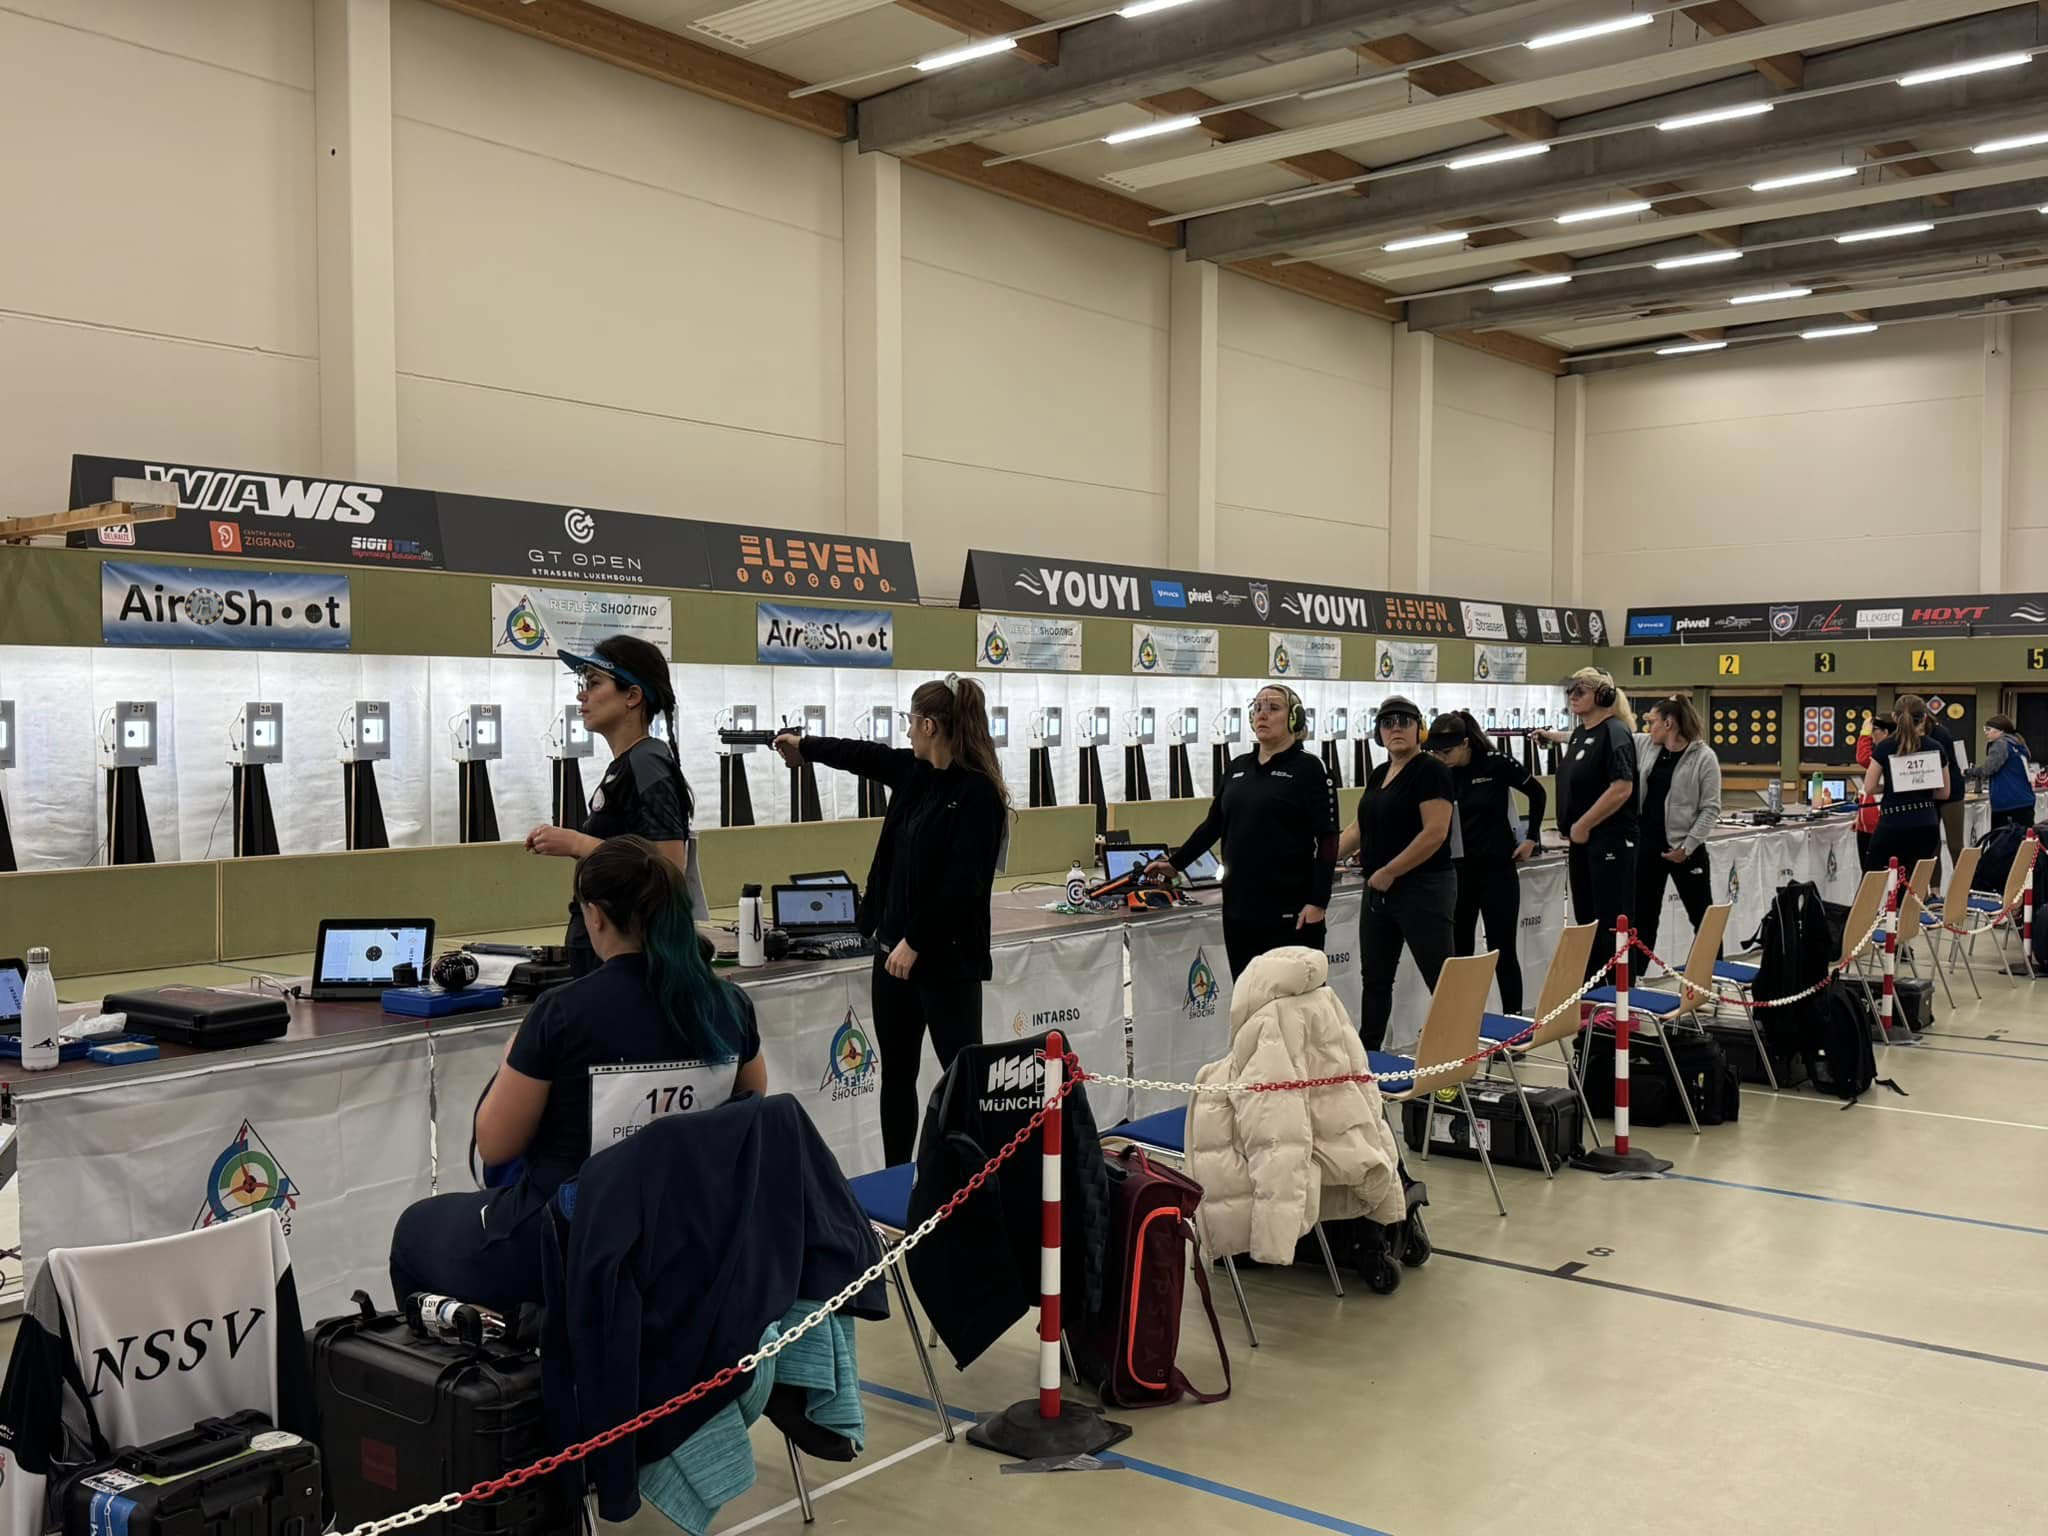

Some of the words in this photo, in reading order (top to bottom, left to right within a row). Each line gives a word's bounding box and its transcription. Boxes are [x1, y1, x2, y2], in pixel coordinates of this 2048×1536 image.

[244, 536, 297, 549] ZIGRAND
[528, 549, 562, 564] GT
[572, 553, 642, 570] OPEN
[739, 534, 880, 576] ELEVEN
[531, 568, 580, 578] STRASSEN
[583, 572, 643, 583] LUXEMBOURG
[1039, 568, 1141, 612] YOUYI
[1187, 587, 1213, 604] piwel
[550, 600, 598, 613] REFLEX
[600, 604, 657, 617] SHOOTING
[1297, 592, 1368, 628] YOUYI
[1385, 597, 1448, 621] ELEVEN
[1911, 606, 1991, 622] HOYT
[1676, 617, 1711, 631] piwel
[1637, 656, 1646, 676] 1
[1724, 655, 1735, 674] 2
[1820, 653, 1830, 673] 3
[1917, 651, 1929, 670] 4
[2033, 648, 2045, 669] 5
[132, 704, 145, 714] 27
[260, 704, 271, 714] 28
[367, 703, 379, 713] 29
[1906, 760, 1925, 769] 217
[1032, 1008, 1081, 1027] INTARSO
[987, 1054, 1035, 1094] HSG
[645, 1084, 695, 1115] 176
[88, 1308, 266, 1398] NSSV
